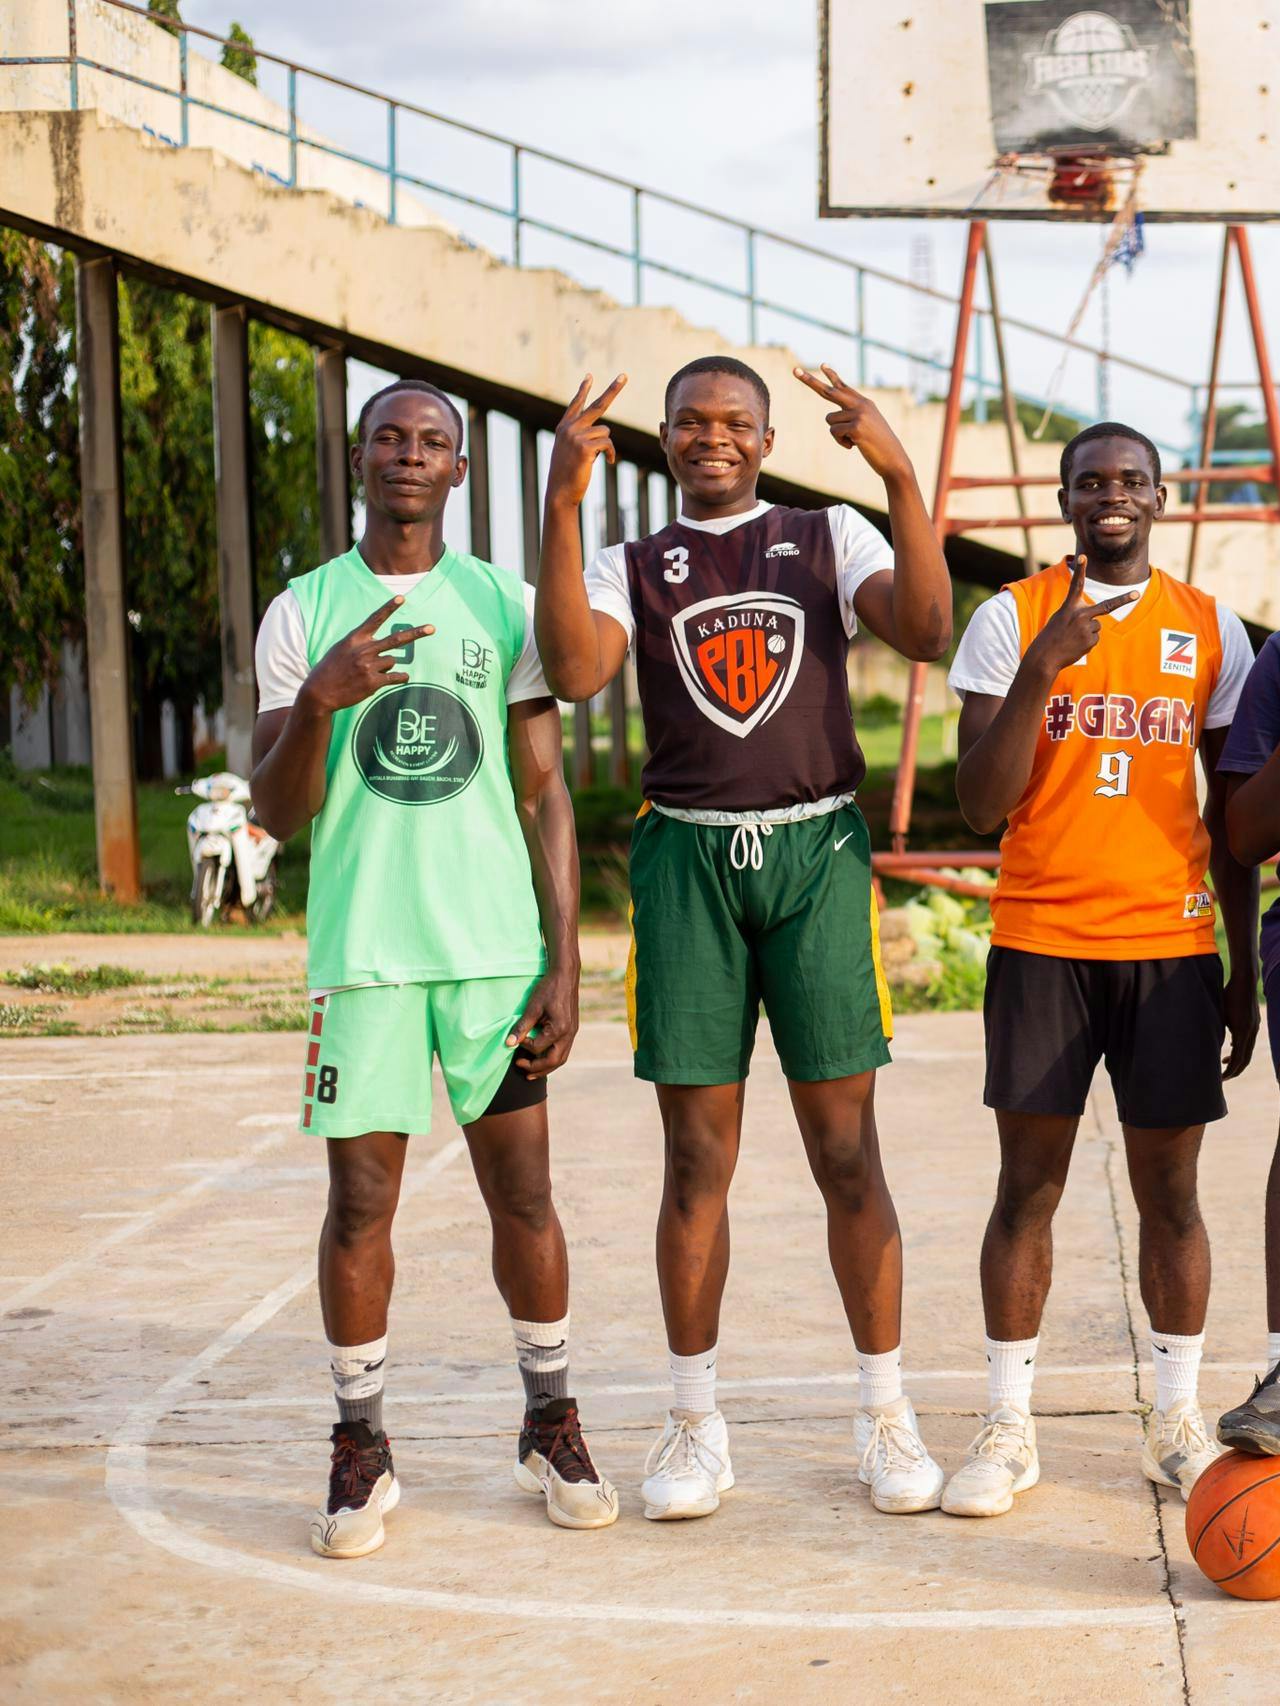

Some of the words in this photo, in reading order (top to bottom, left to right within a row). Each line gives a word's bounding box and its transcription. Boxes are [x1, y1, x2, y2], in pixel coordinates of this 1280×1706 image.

[664, 546, 690, 584] 3
[697, 612, 779, 639] KADUNA
[461, 638, 494, 674] BE
[696, 628, 779, 714] PBL
[1163, 662, 1192, 674] ZENITH
[462, 668, 487, 681] HAPPY
[396, 708, 437, 744] BE
[1045, 693, 1197, 748] #GBAM
[396, 745, 431, 756] HAPPY
[1094, 749, 1134, 799] 9
[317, 1064, 339, 1105] 8
